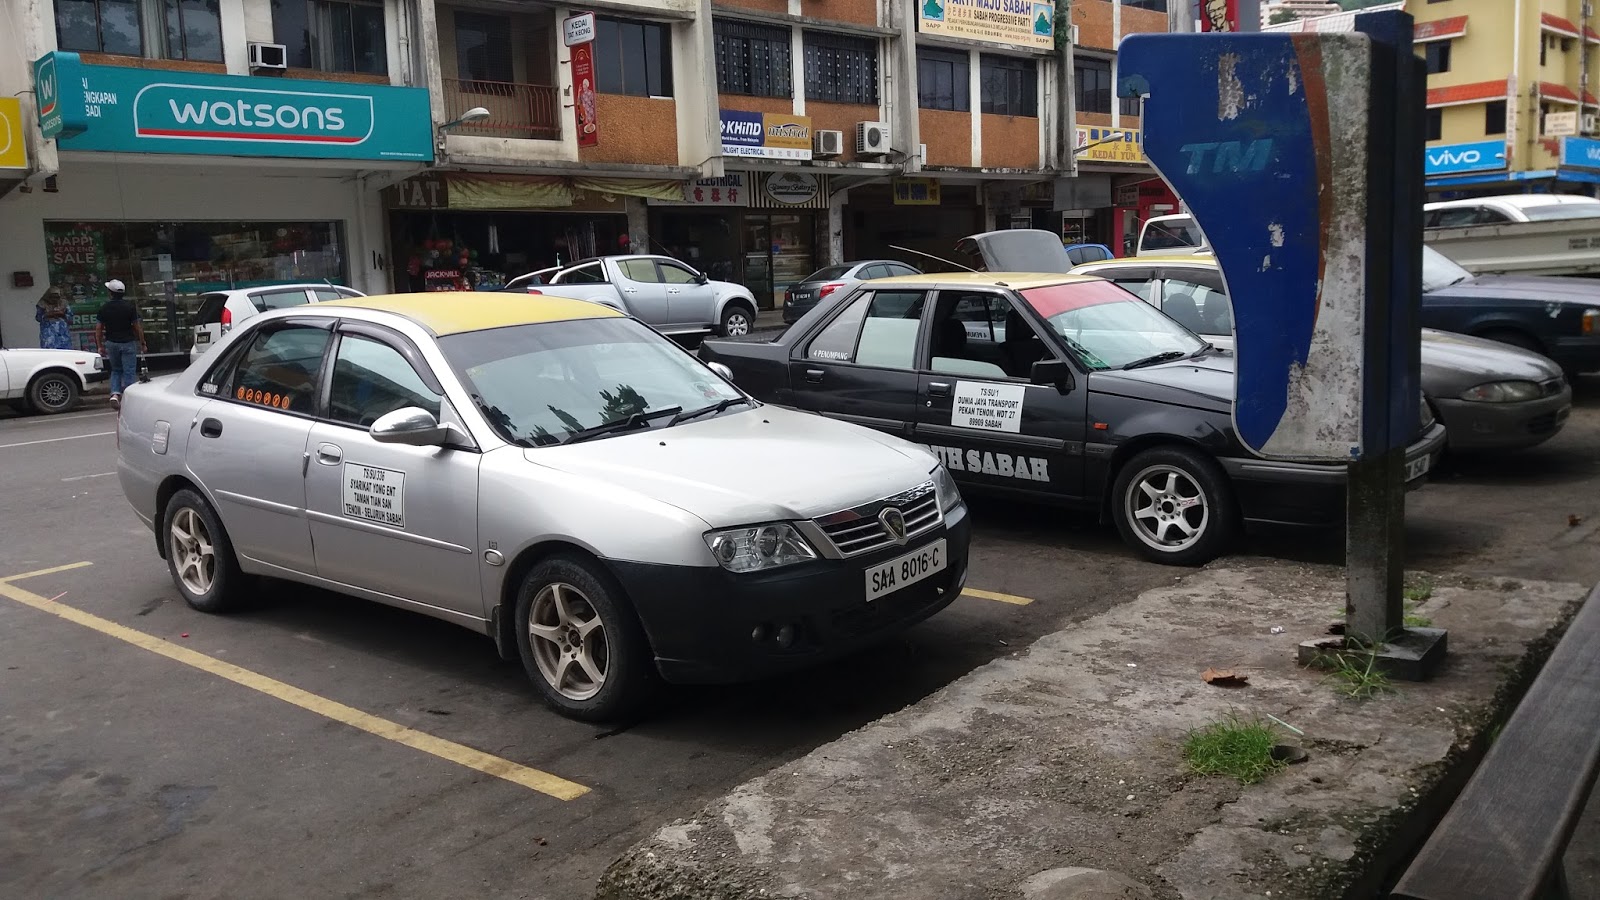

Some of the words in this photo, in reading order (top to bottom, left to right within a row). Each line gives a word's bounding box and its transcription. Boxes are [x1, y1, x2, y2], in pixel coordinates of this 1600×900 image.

[1003, 0, 1031, 16] SABAH
[571, 19, 588, 30] KEDAI
[973, 10, 988, 20] SABAH
[989, 12, 1017, 26] PROGRESSIVE
[1018, 17, 1031, 28] PARTY
[575, 27, 591, 36] KEONG
[169, 98, 346, 131] watsons
[740, 148, 765, 156] ELECTRICAL
[1092, 150, 1116, 160] KEDAI
[1121, 152, 1136, 161] YUN
[1180, 139, 1273, 175] TM
[1428, 150, 1480, 166] vivo
[394, 180, 440, 207] TAT
[54, 253, 96, 265] SALE
[72, 314, 98, 325] REE
[818, 350, 848, 360] PENUMPANG
[958, 396, 973, 405] DUNIA
[974, 398, 987, 407] JAYA
[988, 399, 1019, 409] TRANSPORT
[958, 406, 976, 416] PEKAN
[996, 410, 1008, 419] WDT
[1008, 411, 1016, 419] 27
[969, 417, 984, 427] 89909
[984, 419, 1003, 429] SABAH
[966, 449, 1050, 482] SABAH
[350, 479, 372, 492] SYARIKAT
[373, 483, 385, 495] YONG
[386, 486, 396, 496] ENT
[354, 492, 369, 505] TAMAN
[370, 496, 381, 507] TIAN
[382, 499, 391, 509] SAN
[345, 503, 361, 515] TENOM
[365, 507, 385, 520] SELURUH
[386, 512, 401, 524] SABAH
[872, 566, 896, 593] SAA
